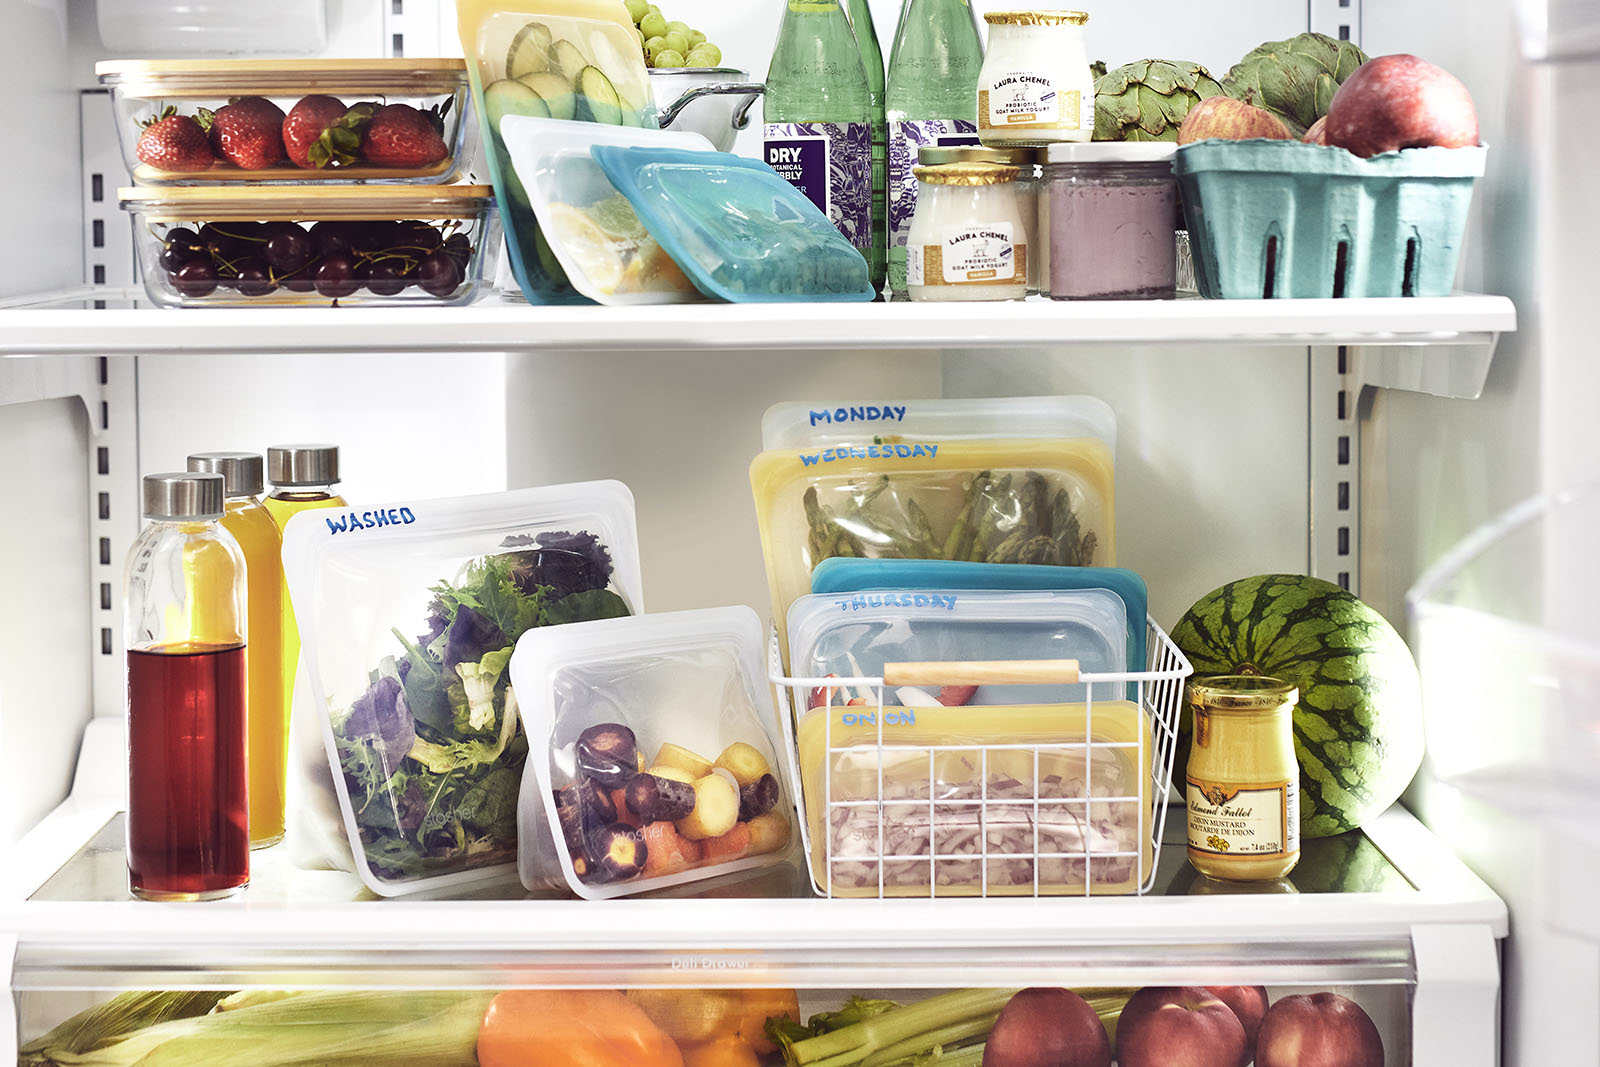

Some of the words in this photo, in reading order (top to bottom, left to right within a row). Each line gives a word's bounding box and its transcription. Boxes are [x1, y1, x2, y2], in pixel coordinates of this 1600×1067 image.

[994, 77, 1018, 90] LAURA
[1019, 76, 1051, 87] CHENEL
[949, 232, 977, 245] LAURA
[980, 231, 1008, 242] CHENEL
[809, 406, 906, 427] MONDAY
[800, 444, 938, 467] WEDNESDAY
[326, 506, 416, 535] WASHED
[834, 593, 957, 611] THURSDAY
[842, 709, 916, 727] ONON
[1221, 806, 1252, 817] Fallot
[1210, 820, 1246, 828] MUSTARD
